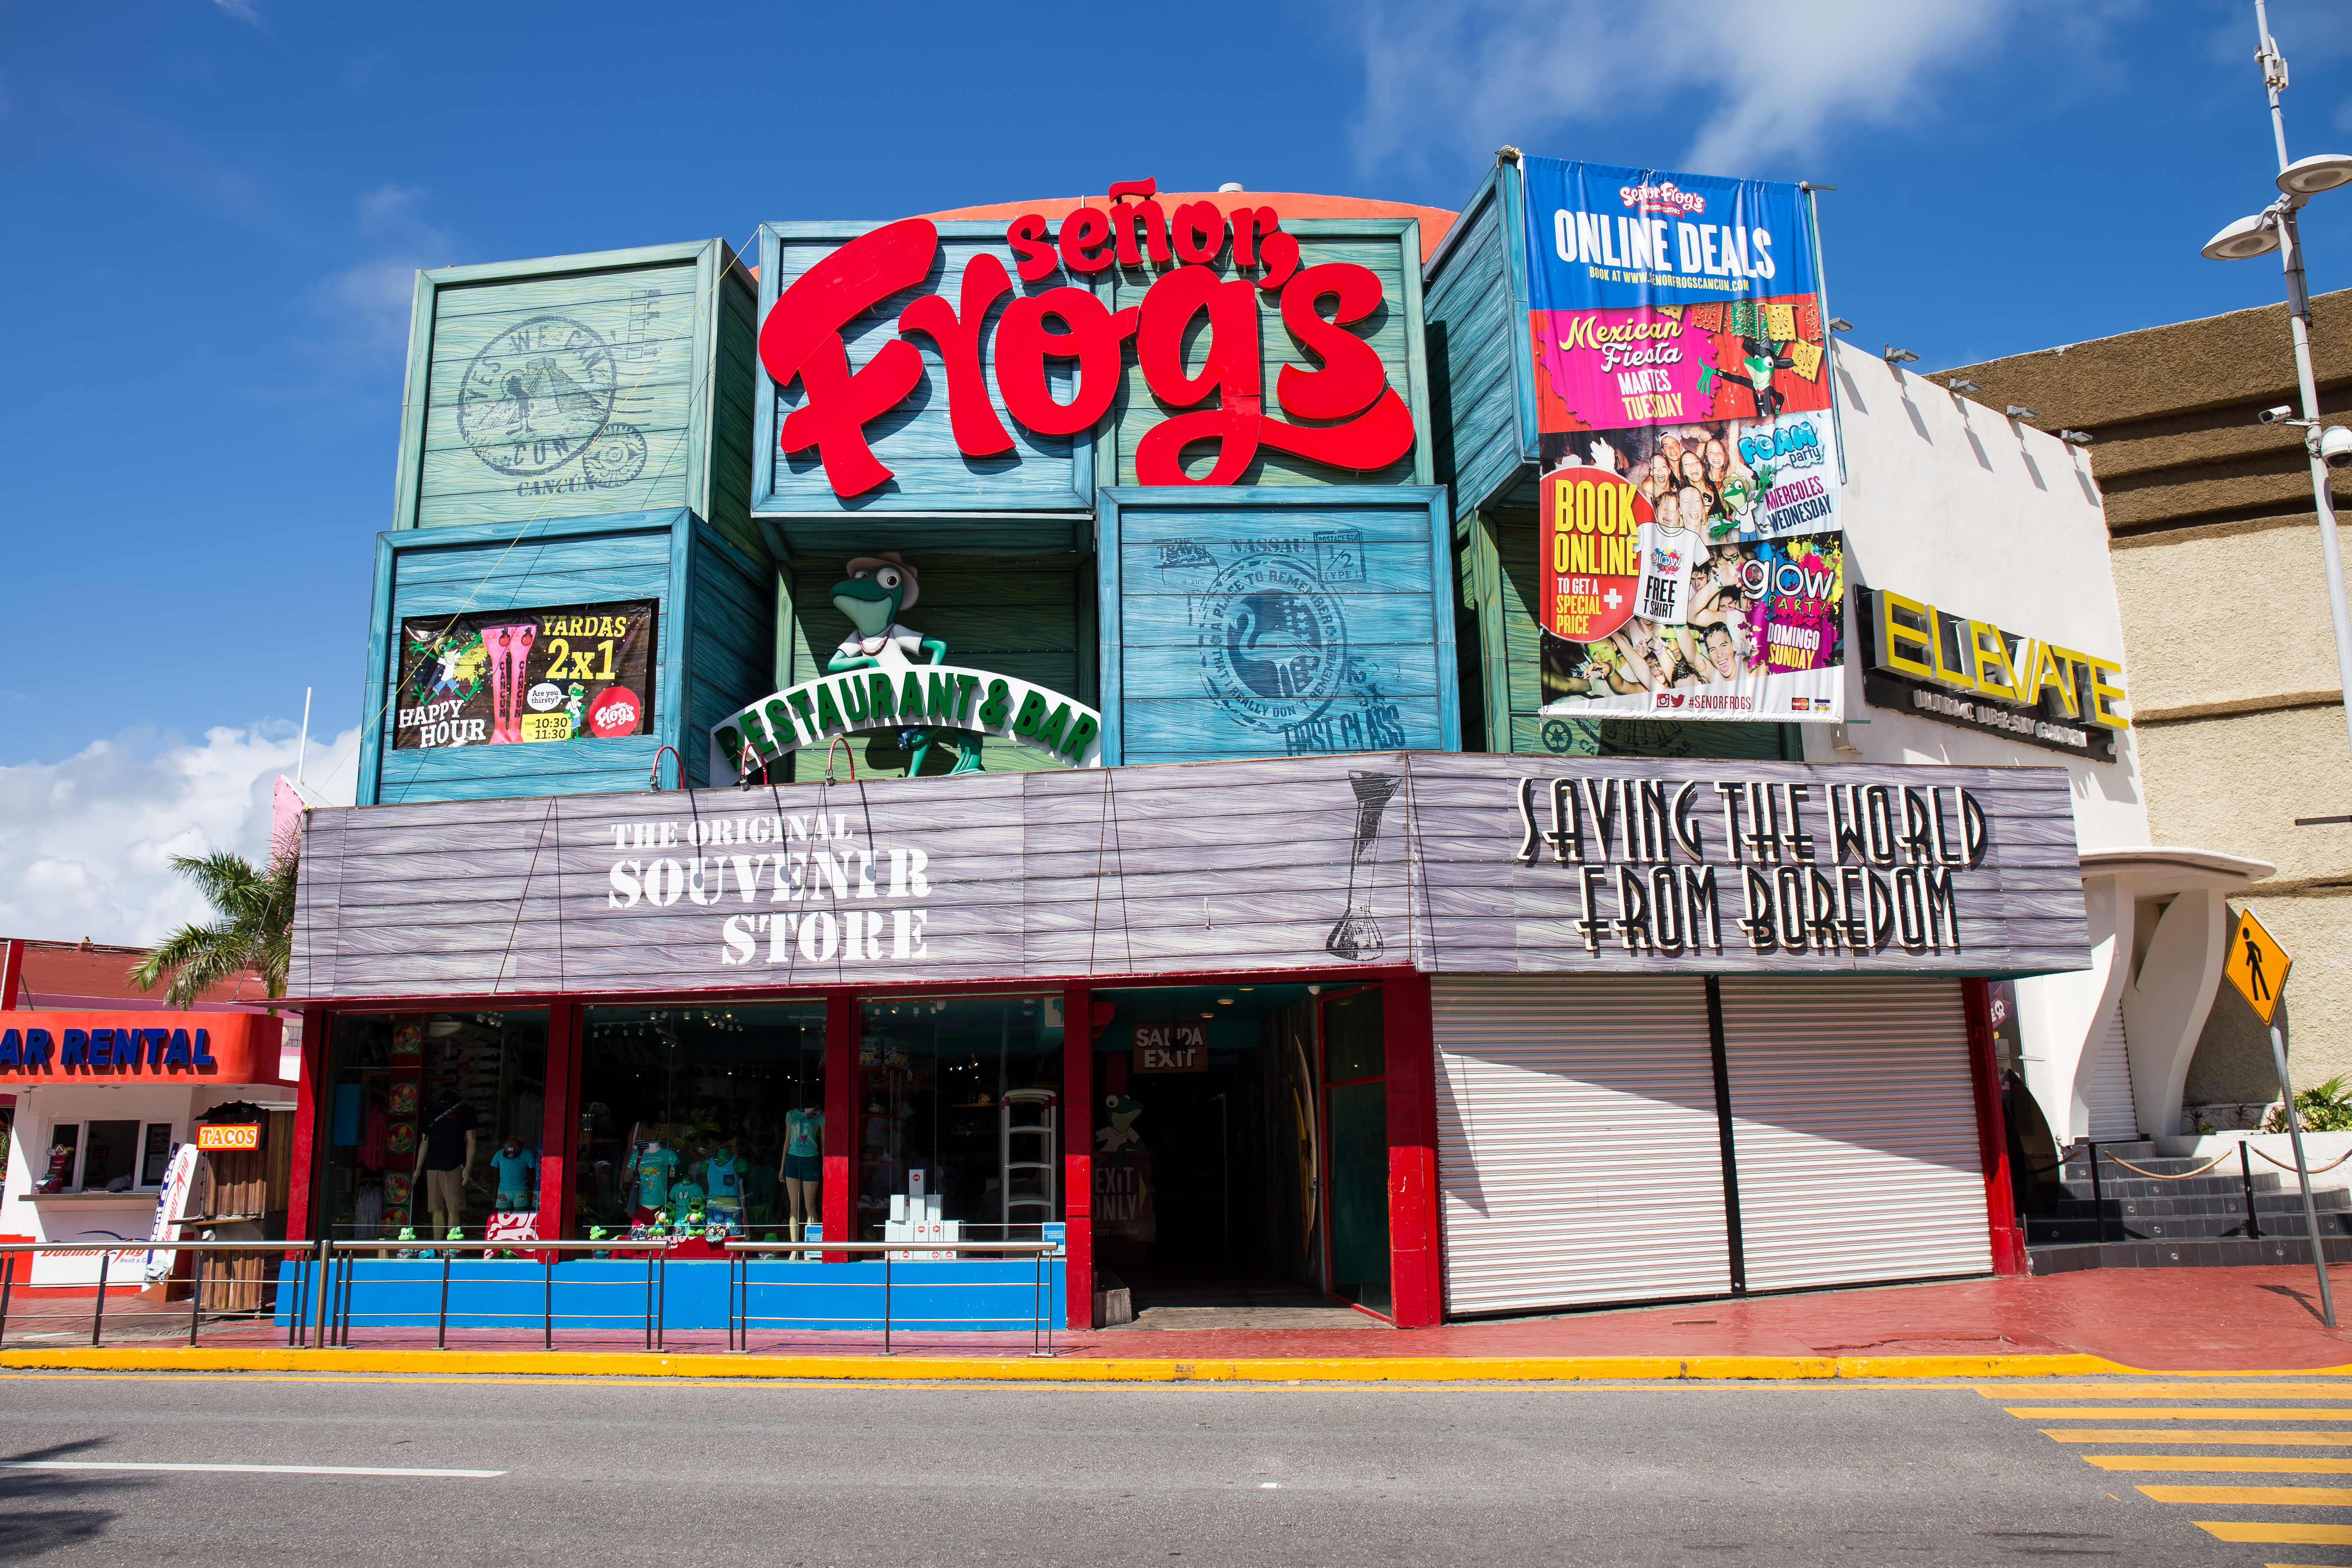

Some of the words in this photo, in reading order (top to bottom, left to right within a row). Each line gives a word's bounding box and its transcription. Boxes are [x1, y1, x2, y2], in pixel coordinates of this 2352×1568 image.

[1619, 185, 1660, 207] Señor
[1007, 175, 1279, 284] señor
[1554, 209, 1672, 272] ONLINE
[1678, 222, 1775, 279] DEALS
[1589, 266, 1610, 281] BOOK
[1611, 270, 1621, 282] AT
[1623, 271, 1750, 291] WWW.SENORFROGSCANCUN.COM
[1559, 316, 1683, 350] Mexican
[1601, 342, 1682, 373] Fiesta
[1617, 368, 1672, 395] MARTES
[1621, 392, 1684, 420] TUESDAY
[1737, 421, 1819, 465] FOAM
[1788, 446, 1822, 467] party
[1555, 479, 1638, 536] BOOK
[1763, 475, 1824, 512] MIERCOLES
[1766, 494, 1833, 533] WEDNESDAY
[1229, 538, 1306, 553] NASSAU
[1554, 533, 1639, 576] ONLINE
[1651, 553, 1682, 567] glow
[1244, 571, 1264, 585] TO
[1322, 570, 1352, 582] TYPE
[1557, 577, 1569, 594] TO
[1571, 577, 1590, 595] GET
[1592, 578, 1599, 595] A
[1645, 575, 1678, 603] FREE
[1741, 556, 1836, 600] glow
[1212, 579, 1245, 619] PLACE
[1268, 570, 1333, 624] REMEMBER
[1556, 594, 1602, 616] SPECIAL
[1650, 600, 1674, 619] SHIRT
[1768, 594, 1827, 616] PARTY
[542, 616, 627, 637] YARDAS
[1211, 622, 1222, 631] A
[1556, 615, 1590, 635] PRICE
[1767, 622, 1820, 652] DOMINGO
[545, 638, 616, 680] 2x1
[1767, 643, 1816, 671] SUNDAY
[1873, 589, 2130, 731] ELEVATE
[514, 660, 525, 718] CANCUN
[1212, 648, 1230, 679] THAT
[1229, 686, 1269, 716] REALLY
[1308, 639, 1337, 697] REMEMBER
[531, 696, 558, 704] thirsty?
[609, 701, 627, 711] señor
[1688, 695, 1751, 710] #SENORFROGS
[399, 700, 465, 729] HAPPY
[535, 717, 568, 729] 10:30
[714, 672, 979, 772] RESTAURANT
[979, 678, 1009, 729] &
[1012, 690, 1099, 763] BAR
[420, 719, 486, 748] HOUR
[535, 729, 566, 739] 11:30
[611, 821, 678, 850] THE
[688, 813, 853, 847] ORIGINAL
[1517, 777, 1702, 862] SAVING
[1713, 781, 1816, 864] THE
[1825, 784, 1989, 867] WORLD
[609, 848, 932, 909] SOUVENIR
[1572, 864, 1722, 950] FROM
[1736, 864, 1960, 949] BOREDOM
[722, 909, 928, 965] STORE
[60, 1029, 214, 1065] RENTAL
[1144, 1049, 1196, 1068] EXIT
[201, 1128, 257, 1146] TACOS
[1095, 1167, 1134, 1193] EXIT
[160, 1189, 167, 1201] a
